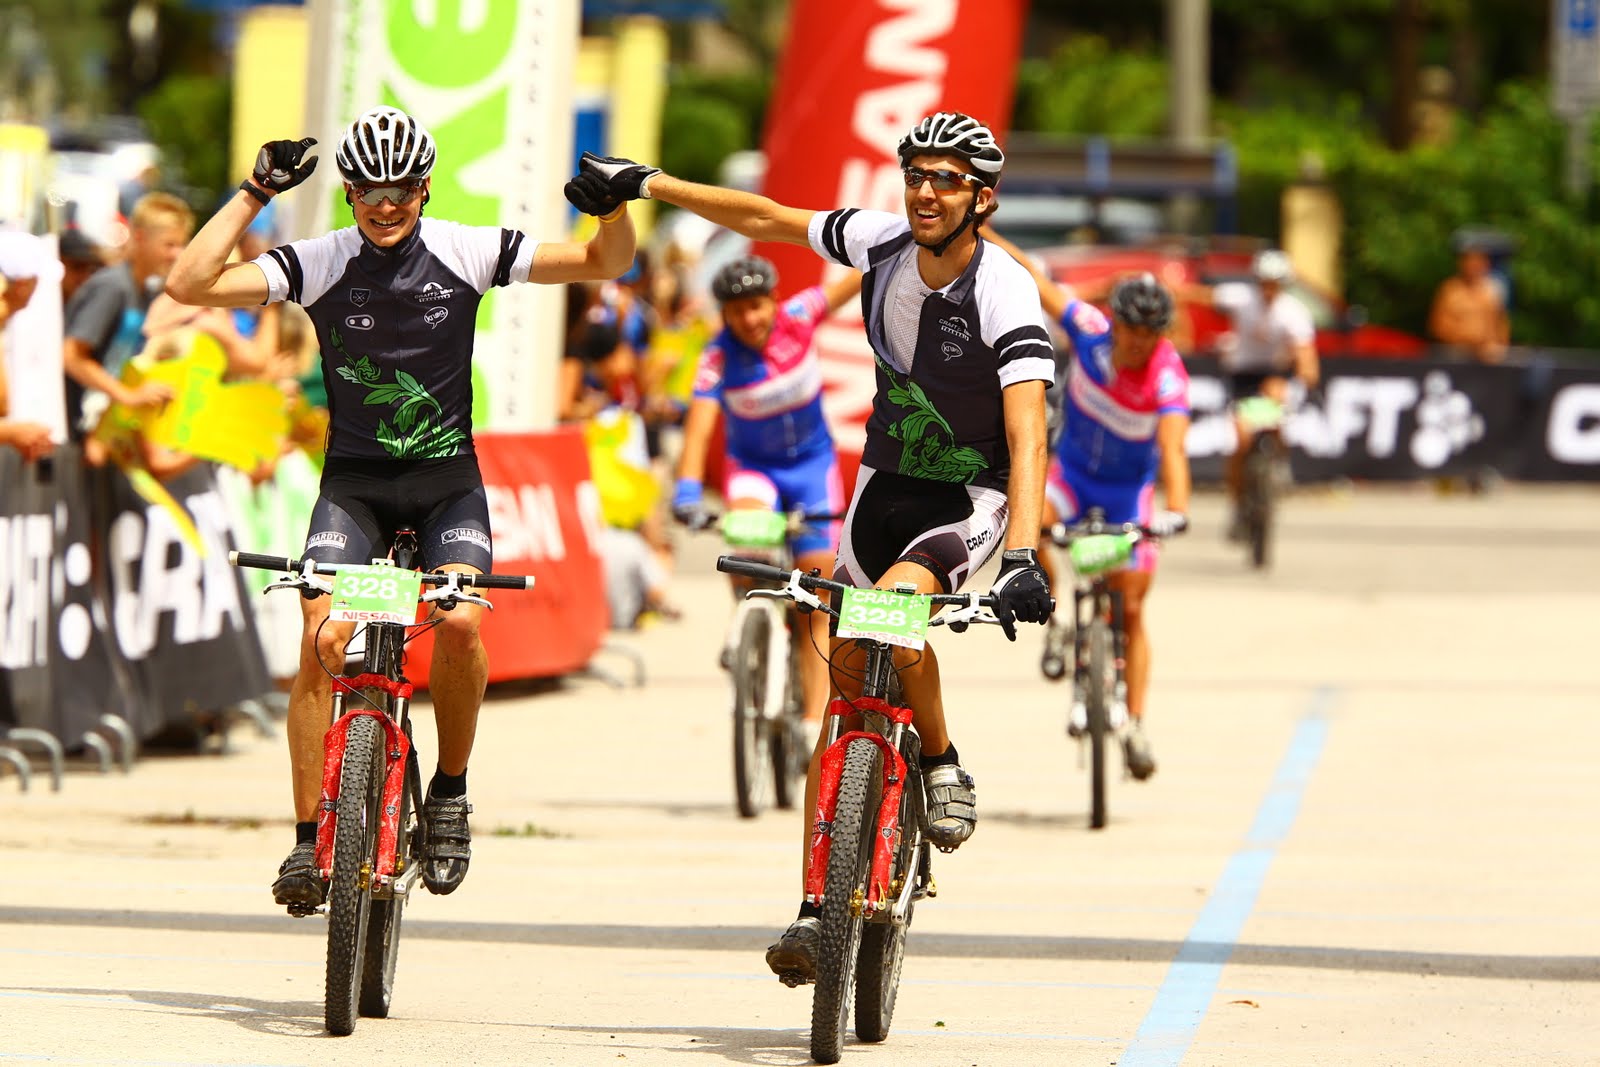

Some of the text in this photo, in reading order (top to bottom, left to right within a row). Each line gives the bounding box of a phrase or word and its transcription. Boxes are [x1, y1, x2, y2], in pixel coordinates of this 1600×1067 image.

[966, 529, 989, 551] CRAFT
[340, 576, 411, 602] 328 1
[851, 591, 908, 607] CRAFT
[342, 611, 403, 622] NISSAN
[847, 605, 923, 630] 328 2
[850, 631, 913, 646] NISSAN
